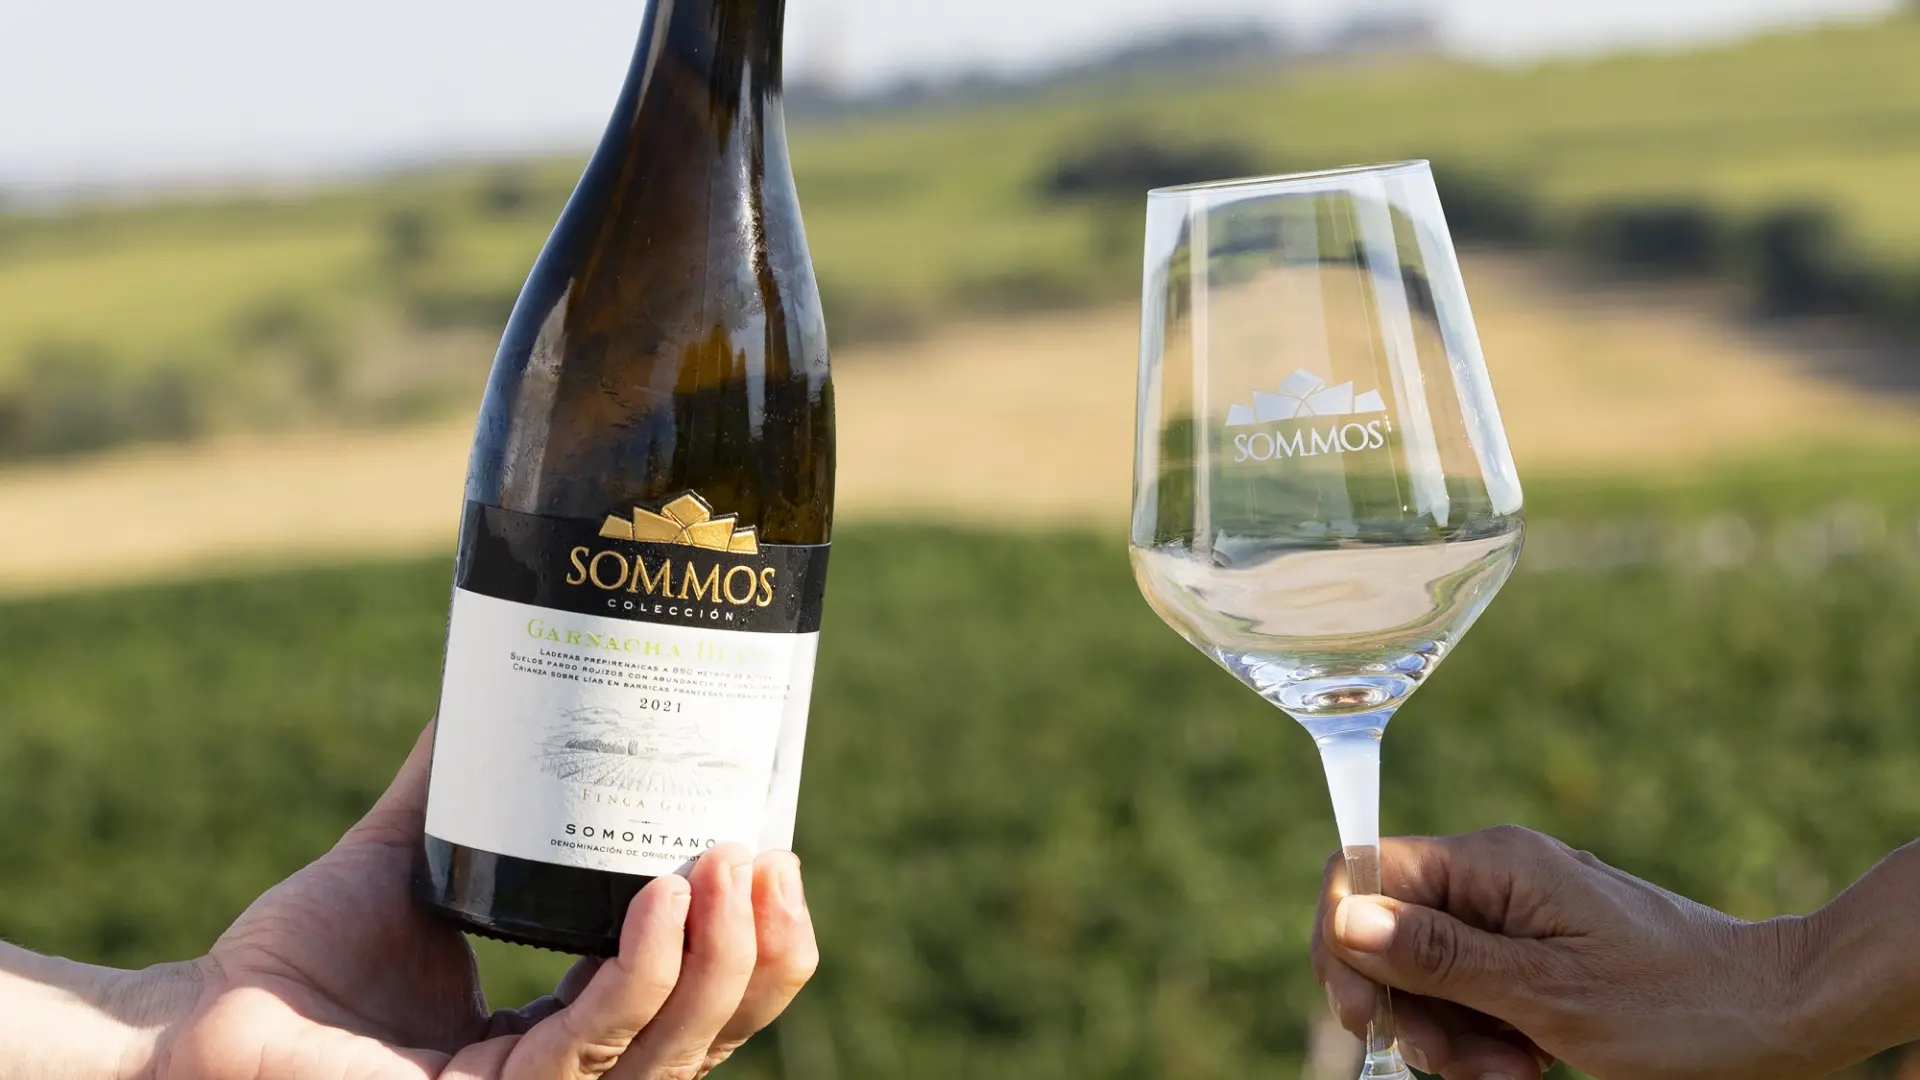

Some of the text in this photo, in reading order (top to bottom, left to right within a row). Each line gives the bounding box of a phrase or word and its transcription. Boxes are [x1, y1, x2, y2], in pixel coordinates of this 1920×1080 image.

[1234, 420, 1384, 463] SOMMOS
[566, 546, 776, 608] SOMMOS
[607, 598, 734, 621] COLECCIÓN
[525, 618, 682, 658] GARNACHA
[510, 652, 543, 666] SUELOS
[547, 661, 578, 672] PARDO
[582, 666, 623, 678] ROJIZOS
[628, 672, 648, 681] CON
[512, 663, 547, 676] CRIANZA
[551, 671, 579, 681] SOBRE
[540, 648, 580, 662] LADERAS
[584, 656, 659, 672] PREPIRENAICAS
[639, 697, 682, 713] 2021
[550, 838, 622, 854] DENOMINACIÓN
[565, 823, 716, 848] SOMONTANO
